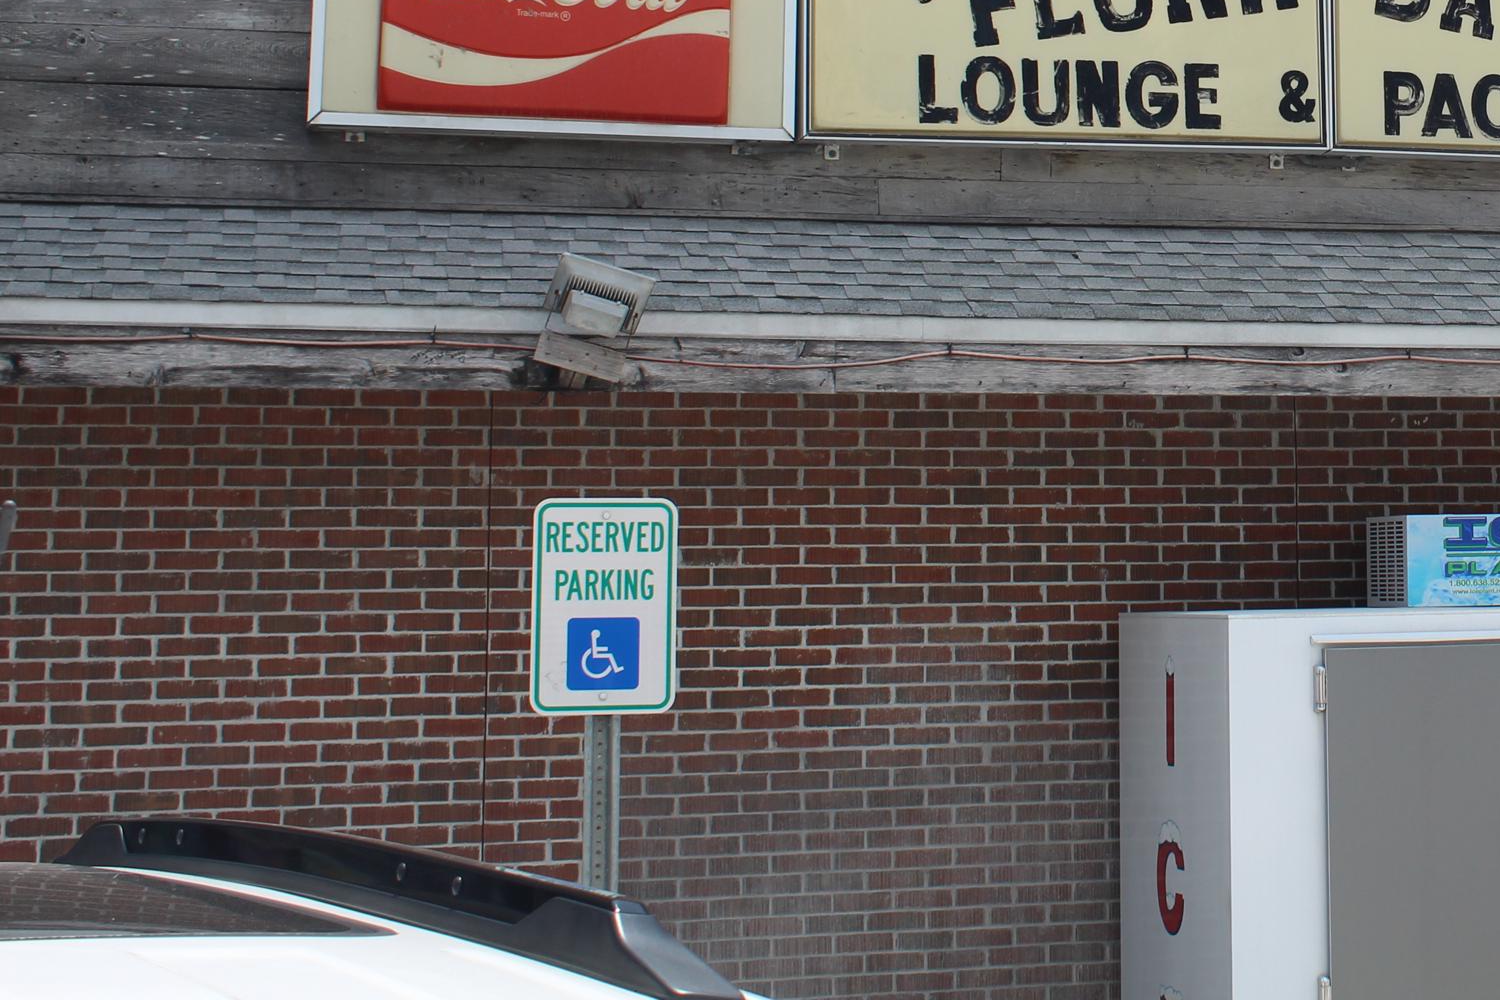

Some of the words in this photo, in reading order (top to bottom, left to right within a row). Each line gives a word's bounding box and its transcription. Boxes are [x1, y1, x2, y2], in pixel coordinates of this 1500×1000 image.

[918, 54, 1222, 131] LOUNGE
[1278, 70, 1316, 124] &
[546, 521, 665, 553] RESERVED
[555, 568, 655, 601] PARKING
